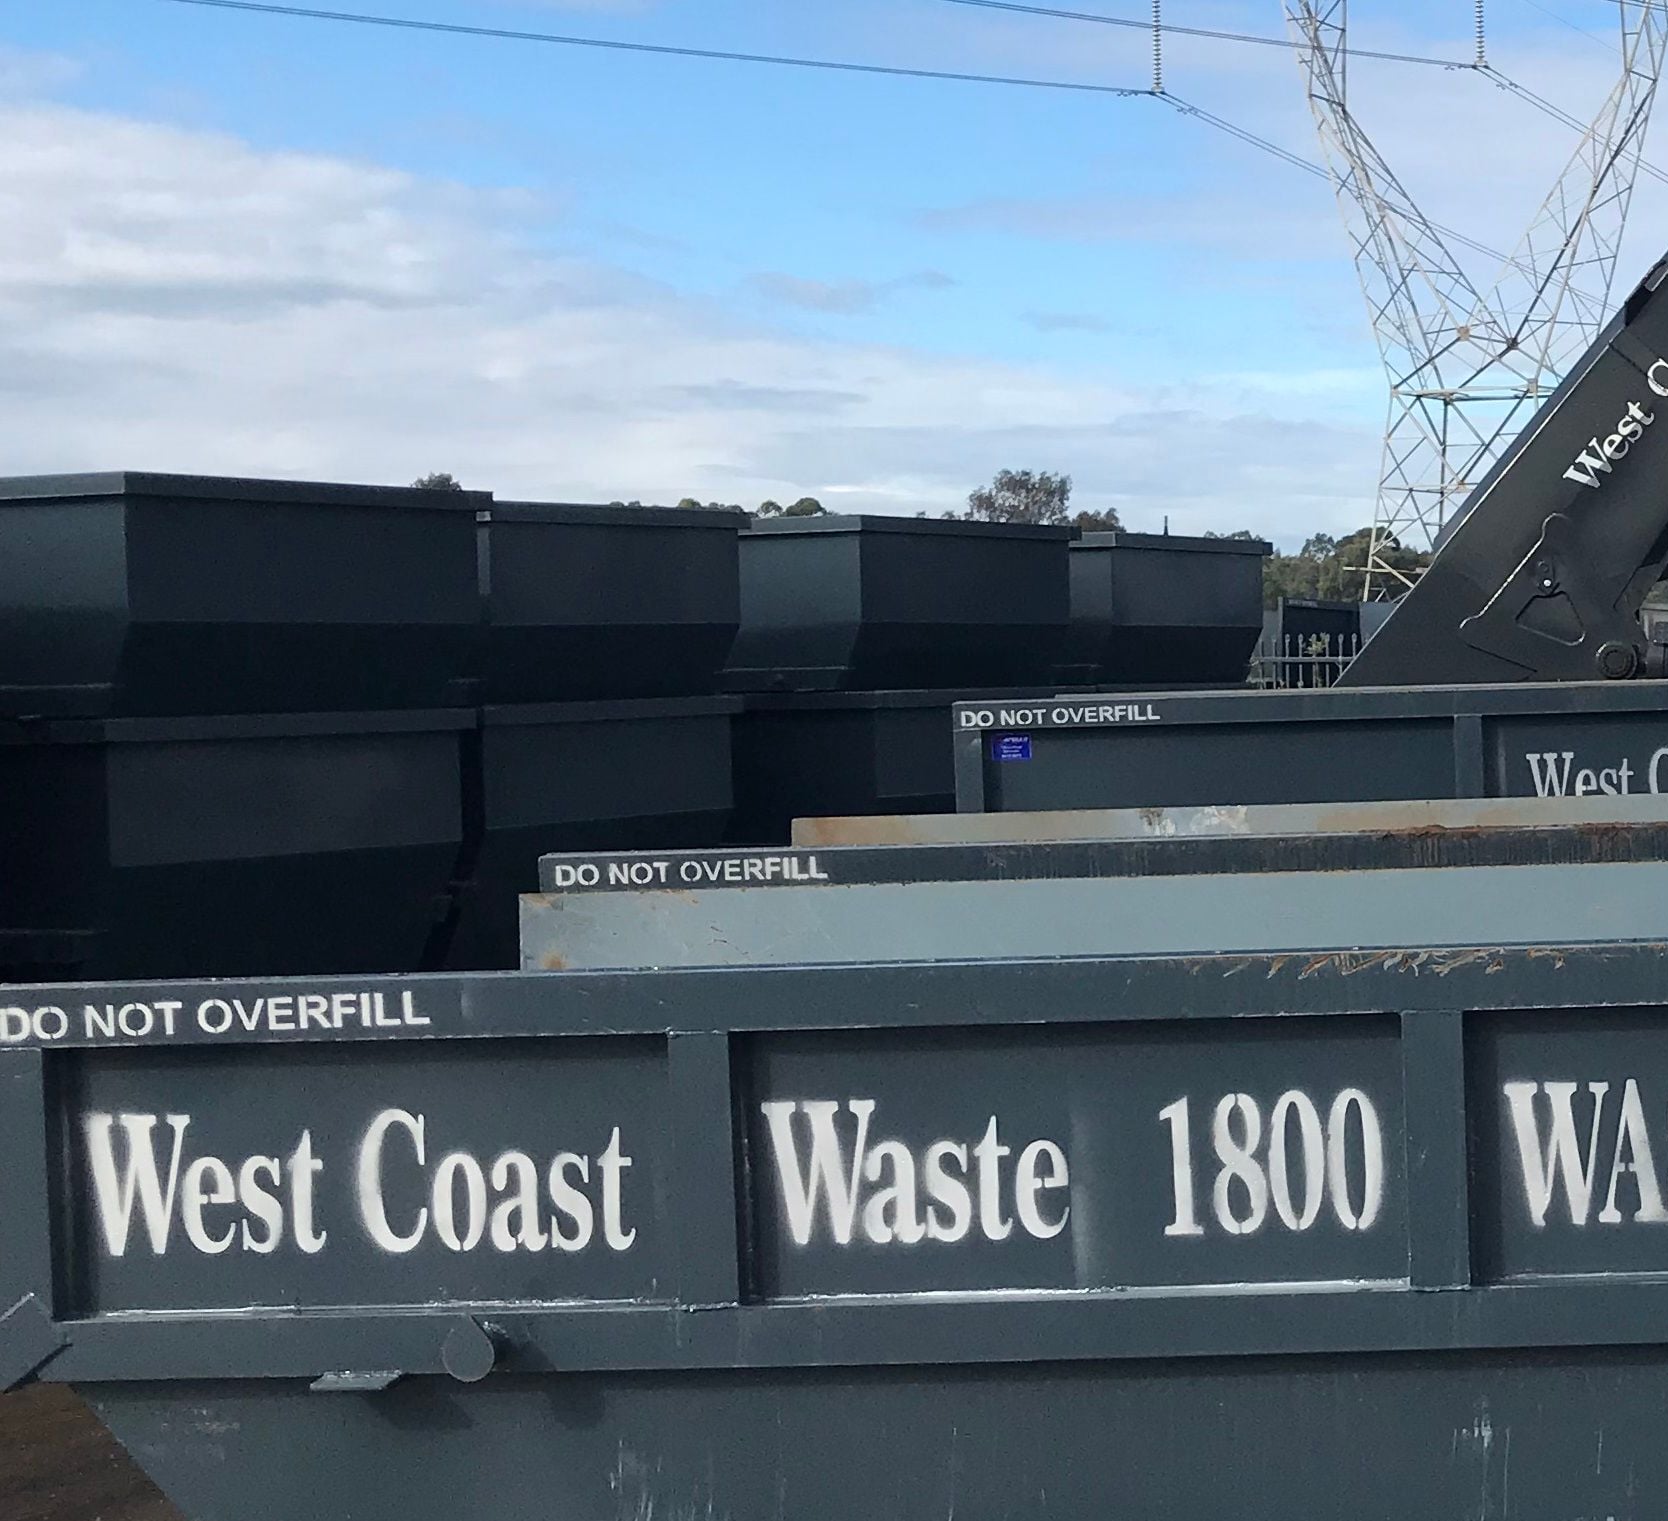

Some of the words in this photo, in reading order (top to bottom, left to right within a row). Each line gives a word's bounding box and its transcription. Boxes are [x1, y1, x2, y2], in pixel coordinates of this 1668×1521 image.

[1562, 401, 1655, 489] West
[960, 710, 995, 727] DO
[1000, 708, 1047, 726] NOT
[1052, 704, 1161, 724] OVERFILL
[1525, 751, 1634, 797] West
[555, 864, 599, 887] DO
[609, 861, 670, 885] NOT
[680, 856, 829, 882] OVERFILL
[0, 1006, 69, 1041] DO
[84, 1001, 182, 1038] NOT
[198, 990, 431, 1033] OVERFILL
[86, 1112, 328, 1257] West
[356, 1107, 638, 1253] Coast
[761, 1099, 1071, 1245] Waste
[1158, 1087, 1384, 1236] 1800
